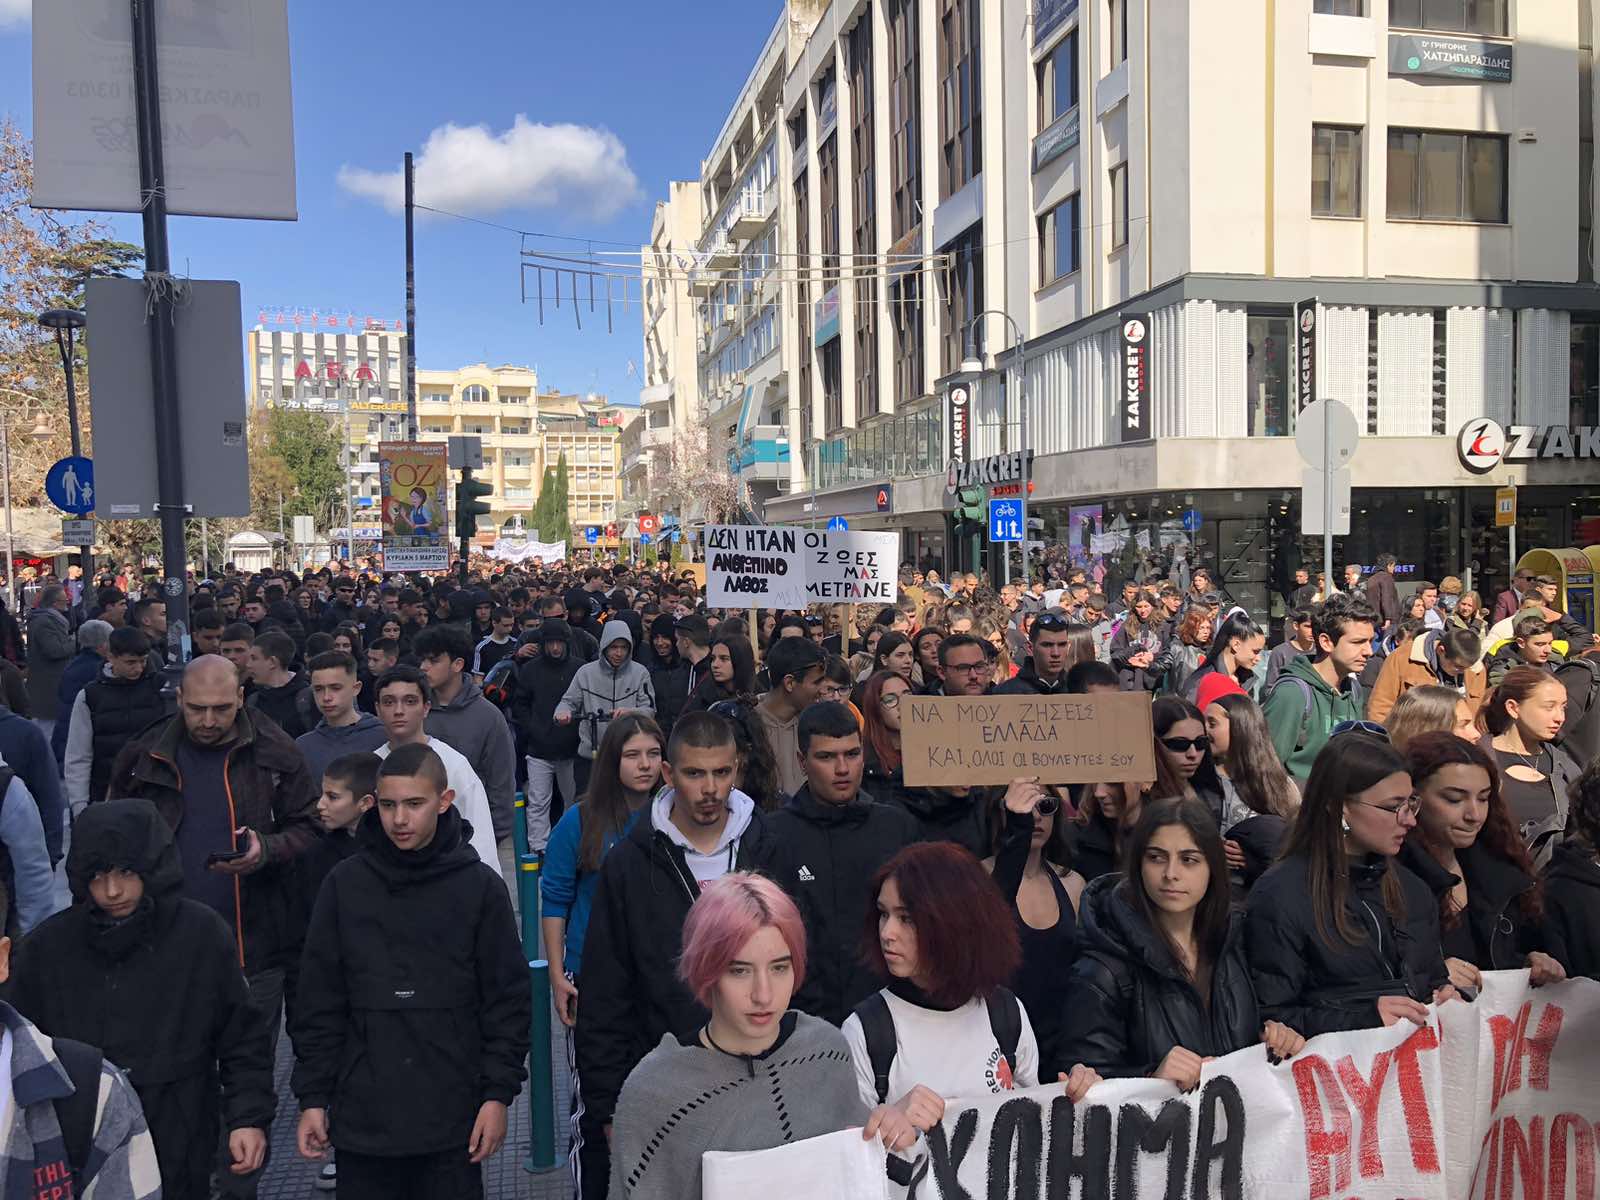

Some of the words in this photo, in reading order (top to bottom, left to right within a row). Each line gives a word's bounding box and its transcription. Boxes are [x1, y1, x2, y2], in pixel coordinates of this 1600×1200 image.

[1431, 41, 1468, 51] ΓΡΗΓΟΡΗΣ
[1423, 50, 1511, 69] ΧΑΤΖΗΠΑΡΑΣΙΔΗΣ
[1127, 346, 1139, 428] ZAKCRET
[953, 407, 963, 463] ZAKCRET
[394, 464, 436, 486] OZ
[958, 449, 1034, 487] ZAKCRET
[708, 528, 738, 550] ΔΕΝ
[746, 530, 796, 553] ΗΤΑΝ
[804, 532, 828, 548] ΟΙ
[712, 553, 788, 576] ΑΝΘΡΩΠΙΝΟ
[816, 550, 878, 567] ΖΩΕΣ
[844, 566, 879, 579] ΜΑΣ
[724, 575, 769, 593] ΛΑΘΟΣ
[911, 703, 943, 722] ΝΑ
[957, 703, 1001, 722] ΜΟΥ
[1019, 703, 1096, 723] ΖΗΣΕΙΣ
[983, 722, 1059, 744] ΕΛΛΑΔΑ
[1013, 752, 1028, 767] ΟΙ
[1032, 752, 1105, 766] ΒΟΥΛΕΥΤΕΣ
[1110, 753, 1135, 767] ΣΟΥ
[985, 1069, 1001, 1094] RED
[1292, 1026, 1442, 1200] ΑΥΤ
[887, 1076, 1247, 1200] ΚΛΗΜΑ
